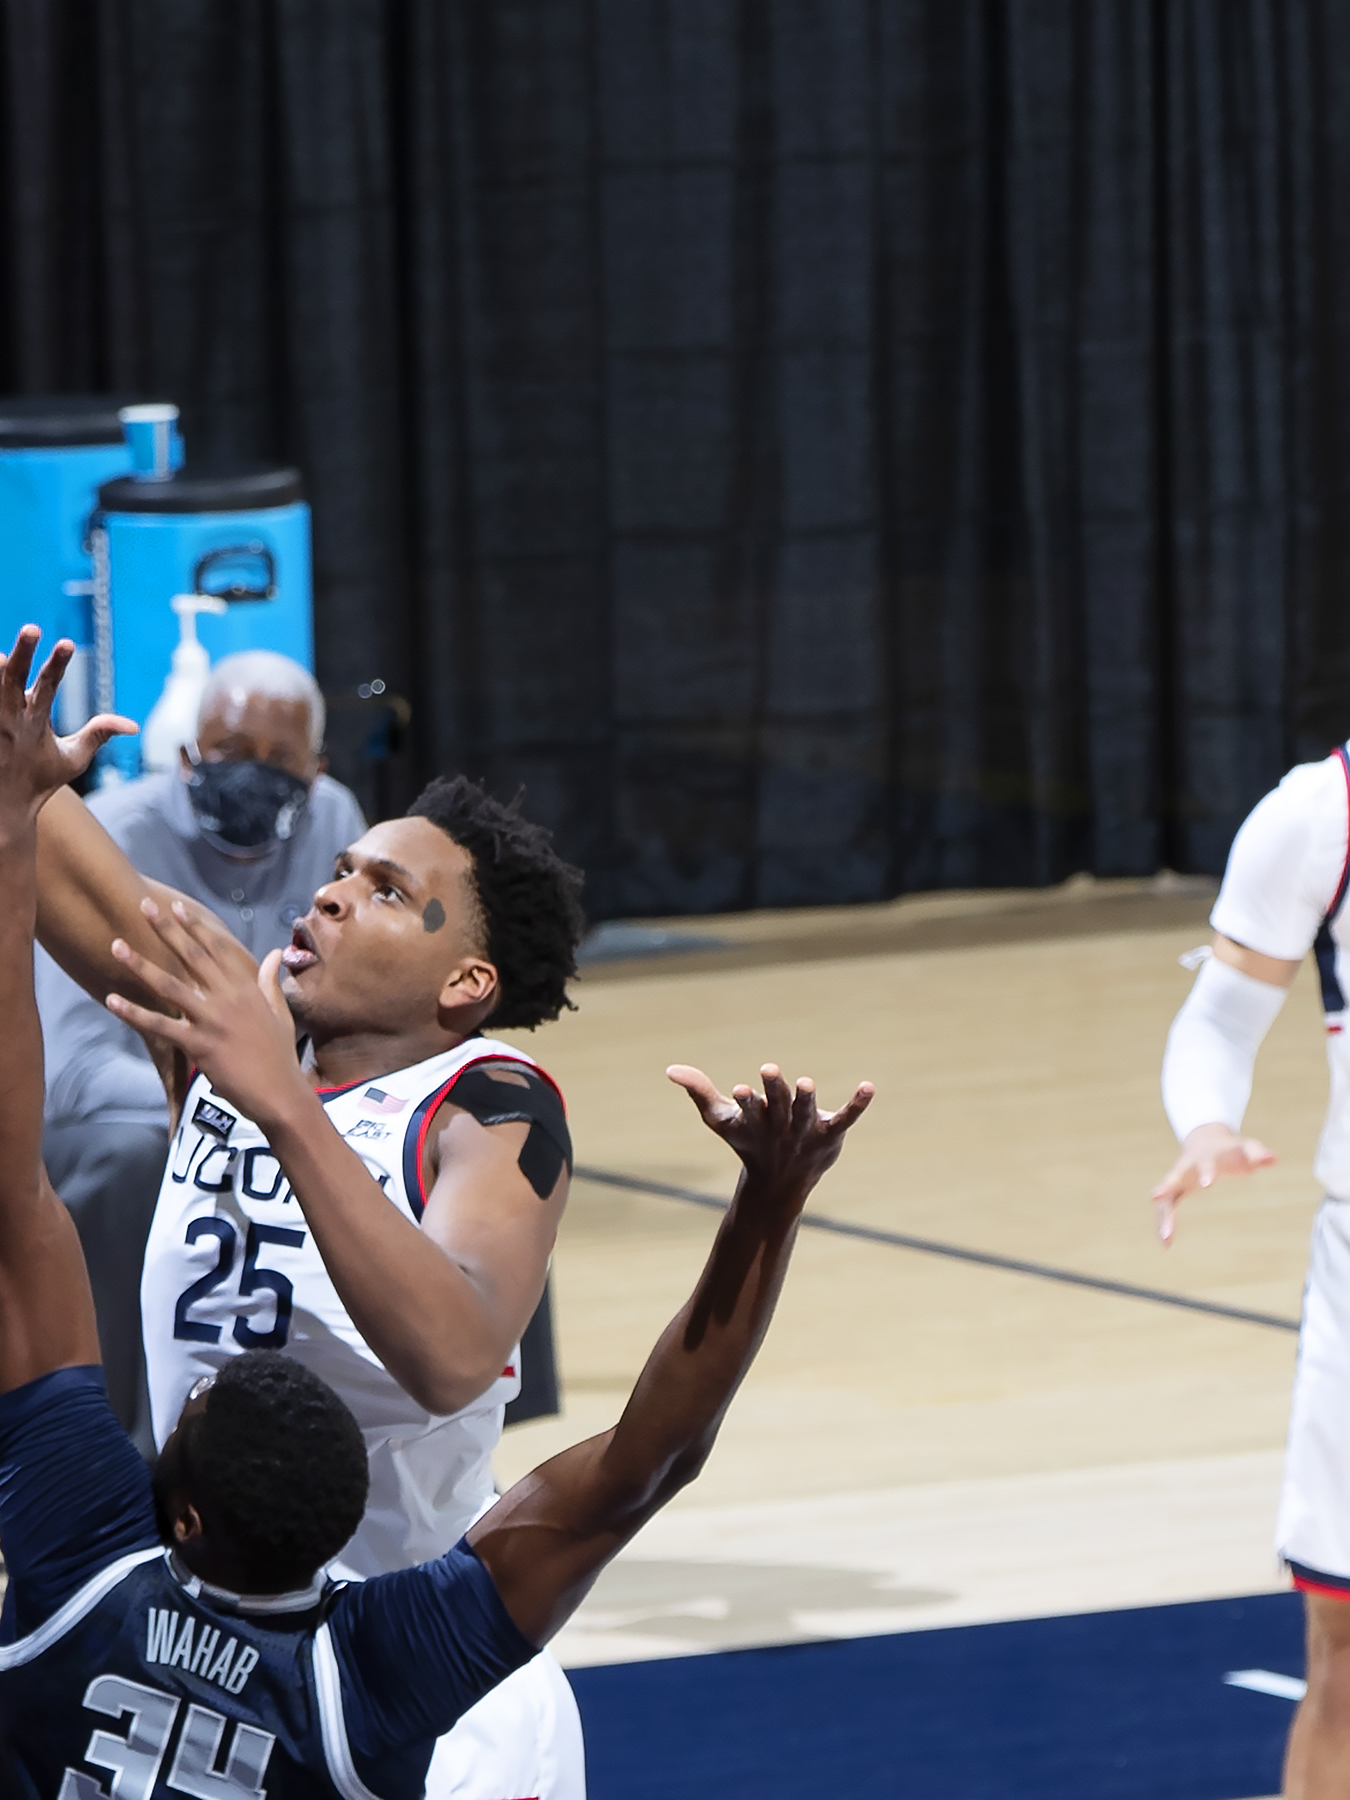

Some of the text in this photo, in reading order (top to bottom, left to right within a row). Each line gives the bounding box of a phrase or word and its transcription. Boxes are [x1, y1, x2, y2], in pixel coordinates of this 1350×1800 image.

[173, 1216, 306, 1350] 25
[146, 1607, 260, 1695] WAHAB
[56, 1674, 276, 1800] 34
